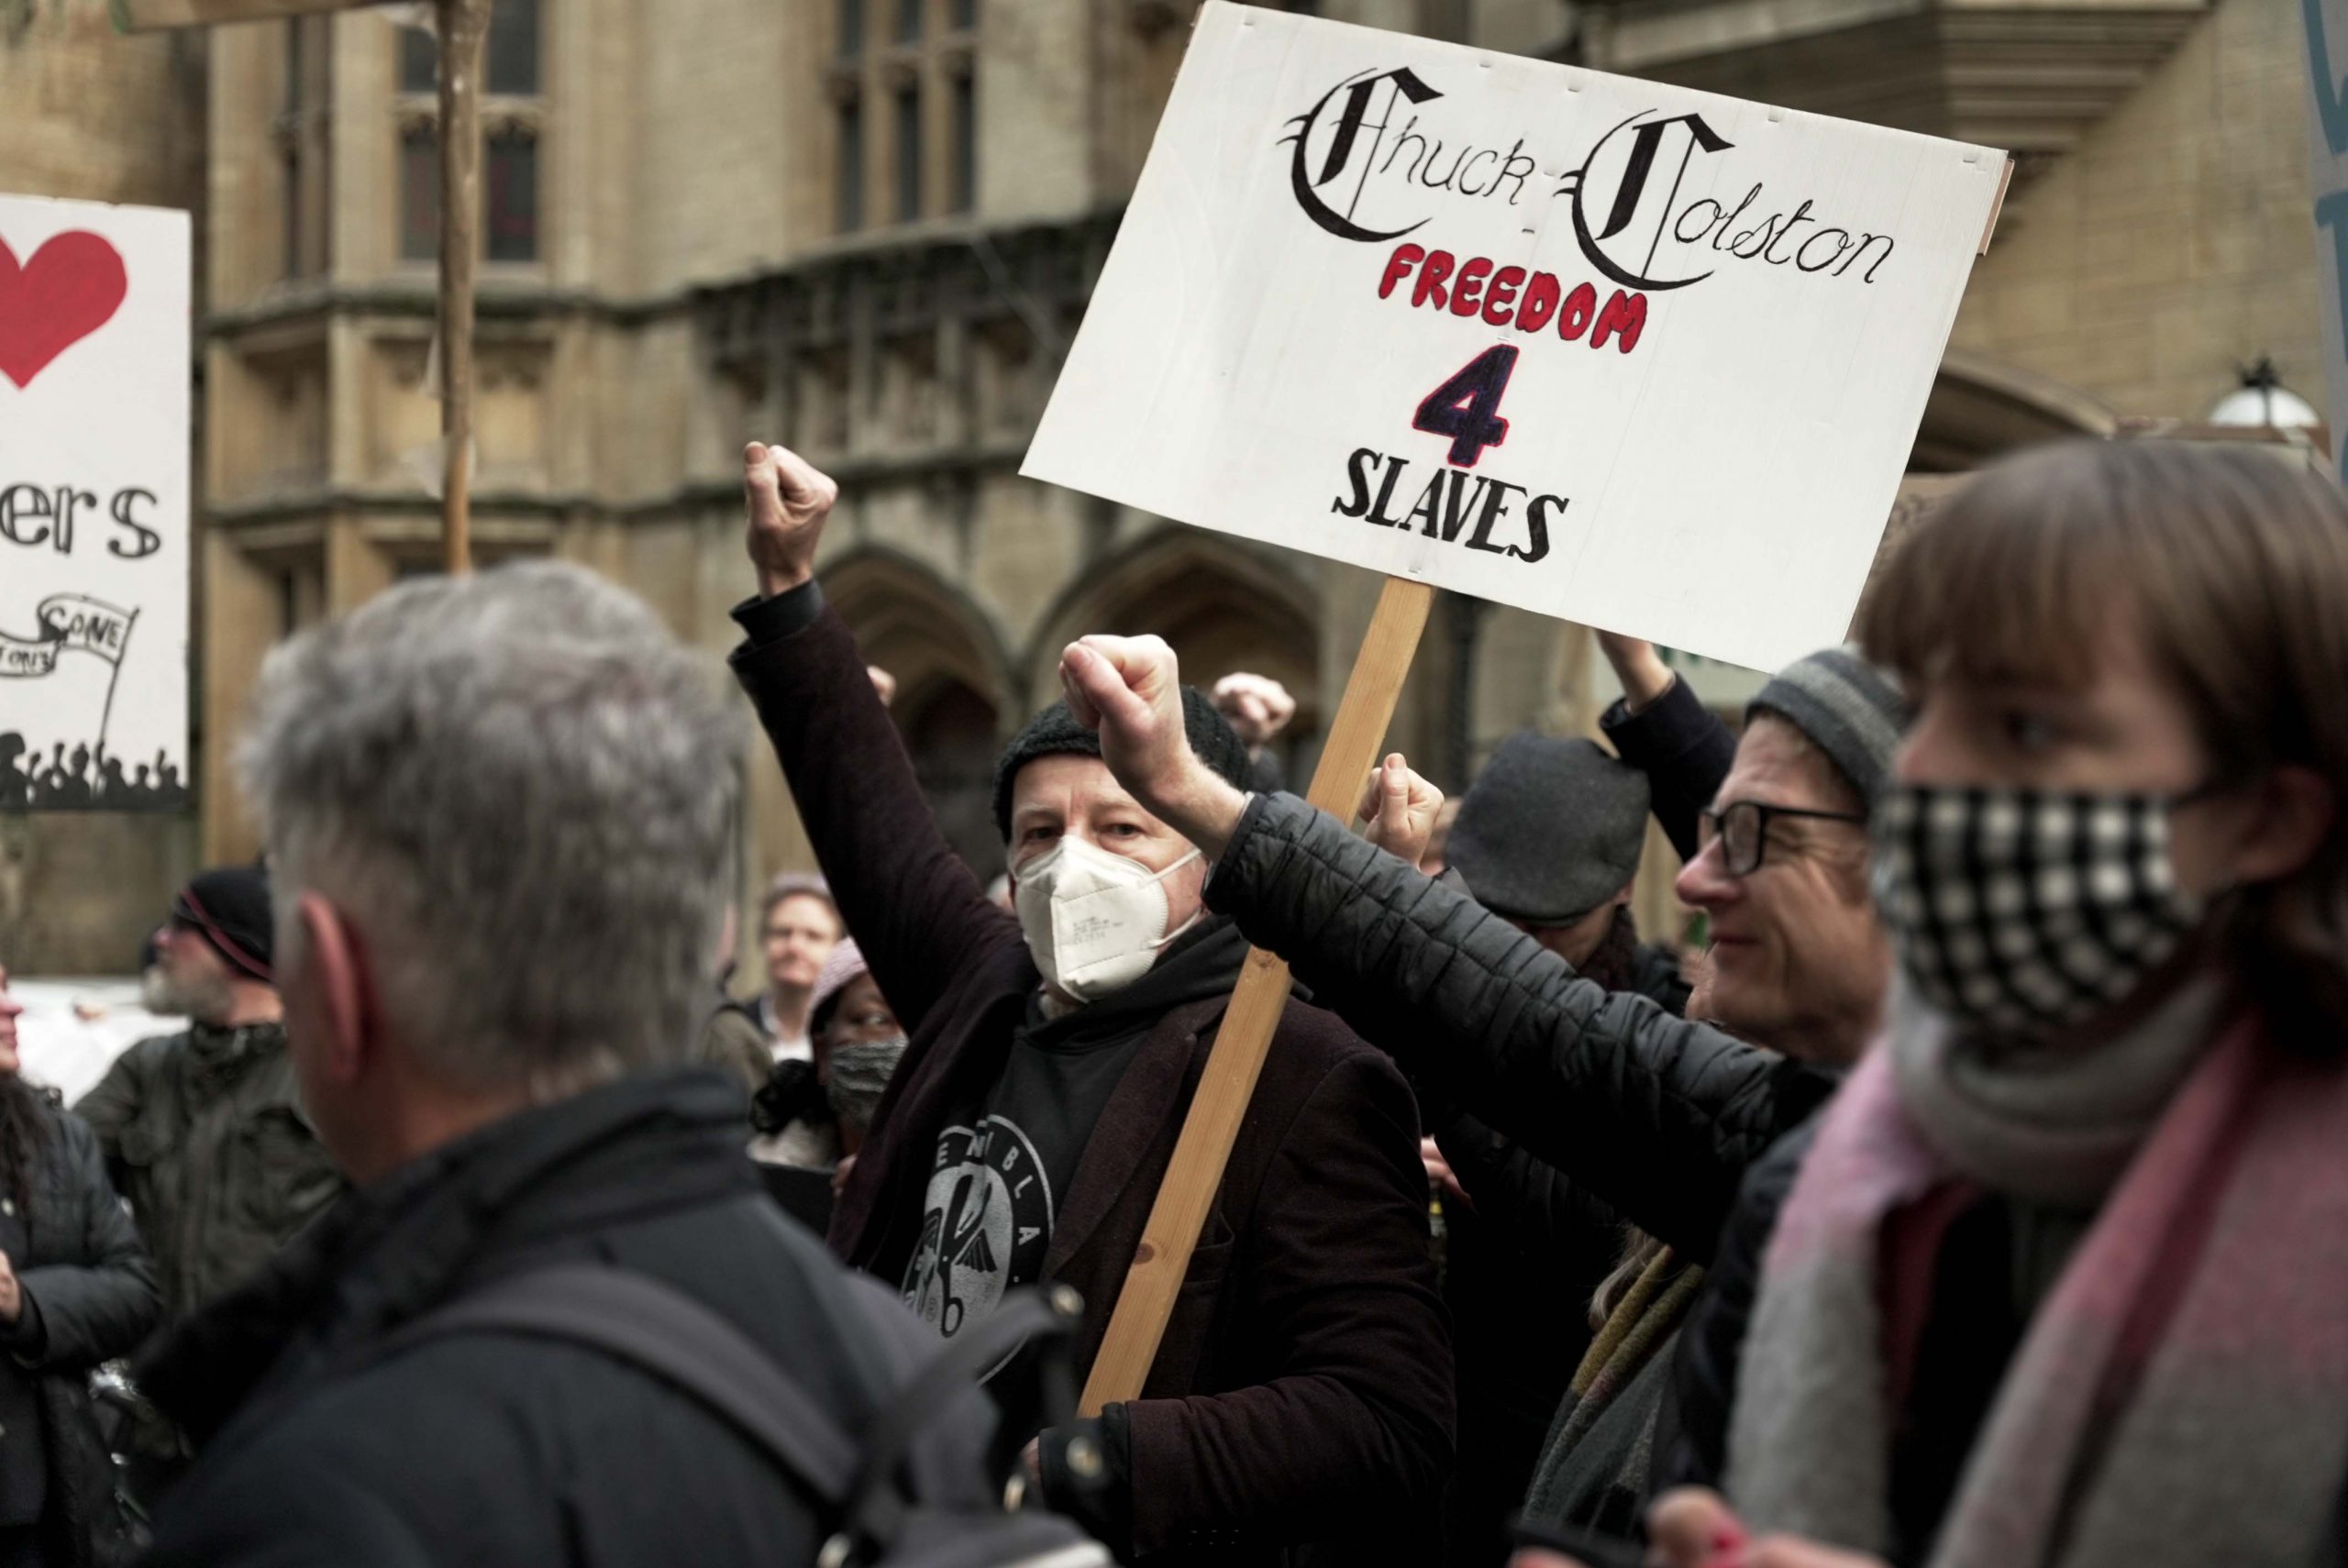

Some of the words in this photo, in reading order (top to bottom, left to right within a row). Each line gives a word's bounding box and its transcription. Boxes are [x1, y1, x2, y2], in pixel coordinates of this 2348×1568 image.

[1276, 66, 1536, 243] Chuck
[1552, 108, 1895, 291] Colston
[1378, 243, 1648, 354] FREEDOM
[1412, 344, 1520, 469] 4
[0, 484, 161, 558] ers
[1331, 447, 1570, 563] SLAVES
